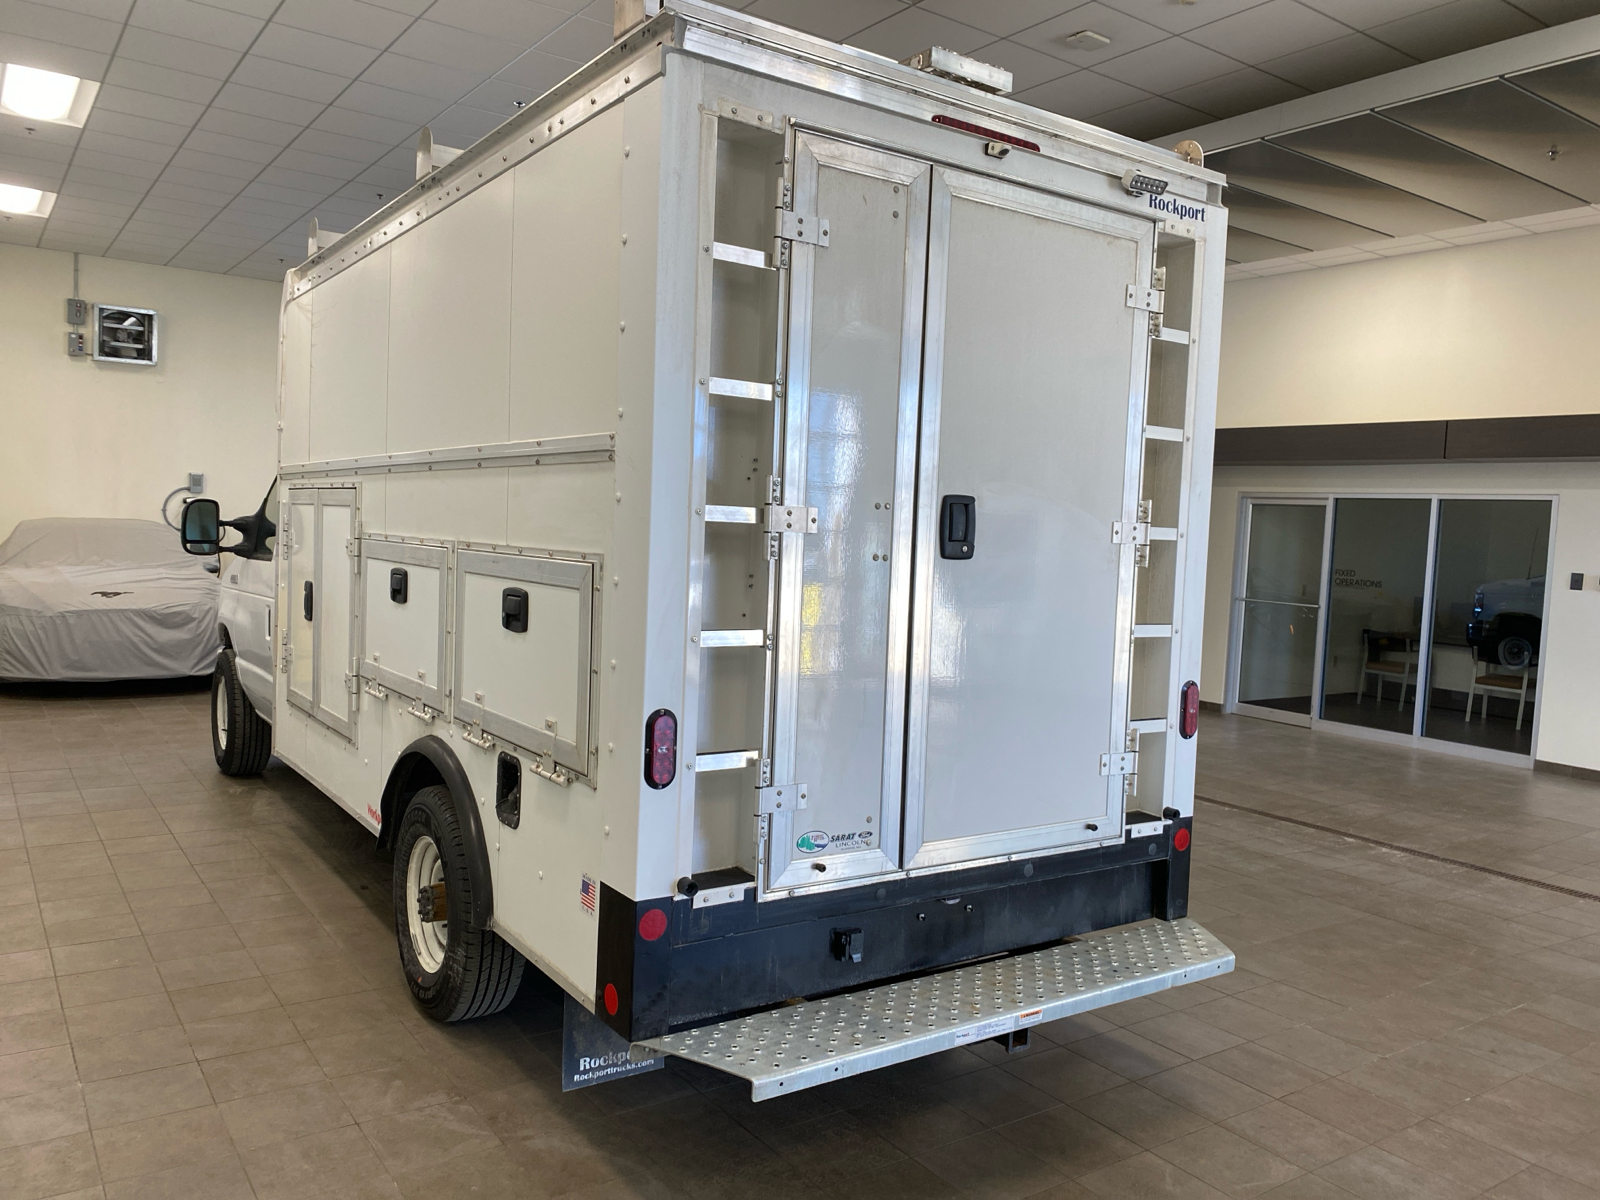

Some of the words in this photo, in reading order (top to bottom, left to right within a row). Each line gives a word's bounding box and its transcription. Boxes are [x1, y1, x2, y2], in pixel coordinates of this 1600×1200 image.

[1149, 194, 1206, 222] Rockport
[1334, 569, 1356, 577] FIXED
[1334, 577, 1383, 588] OPERATIONS
[829, 832, 857, 843] SARAT
[835, 840, 866, 849] LINCOLN
[573, 1058, 655, 1082] Rockporttrucks.com
